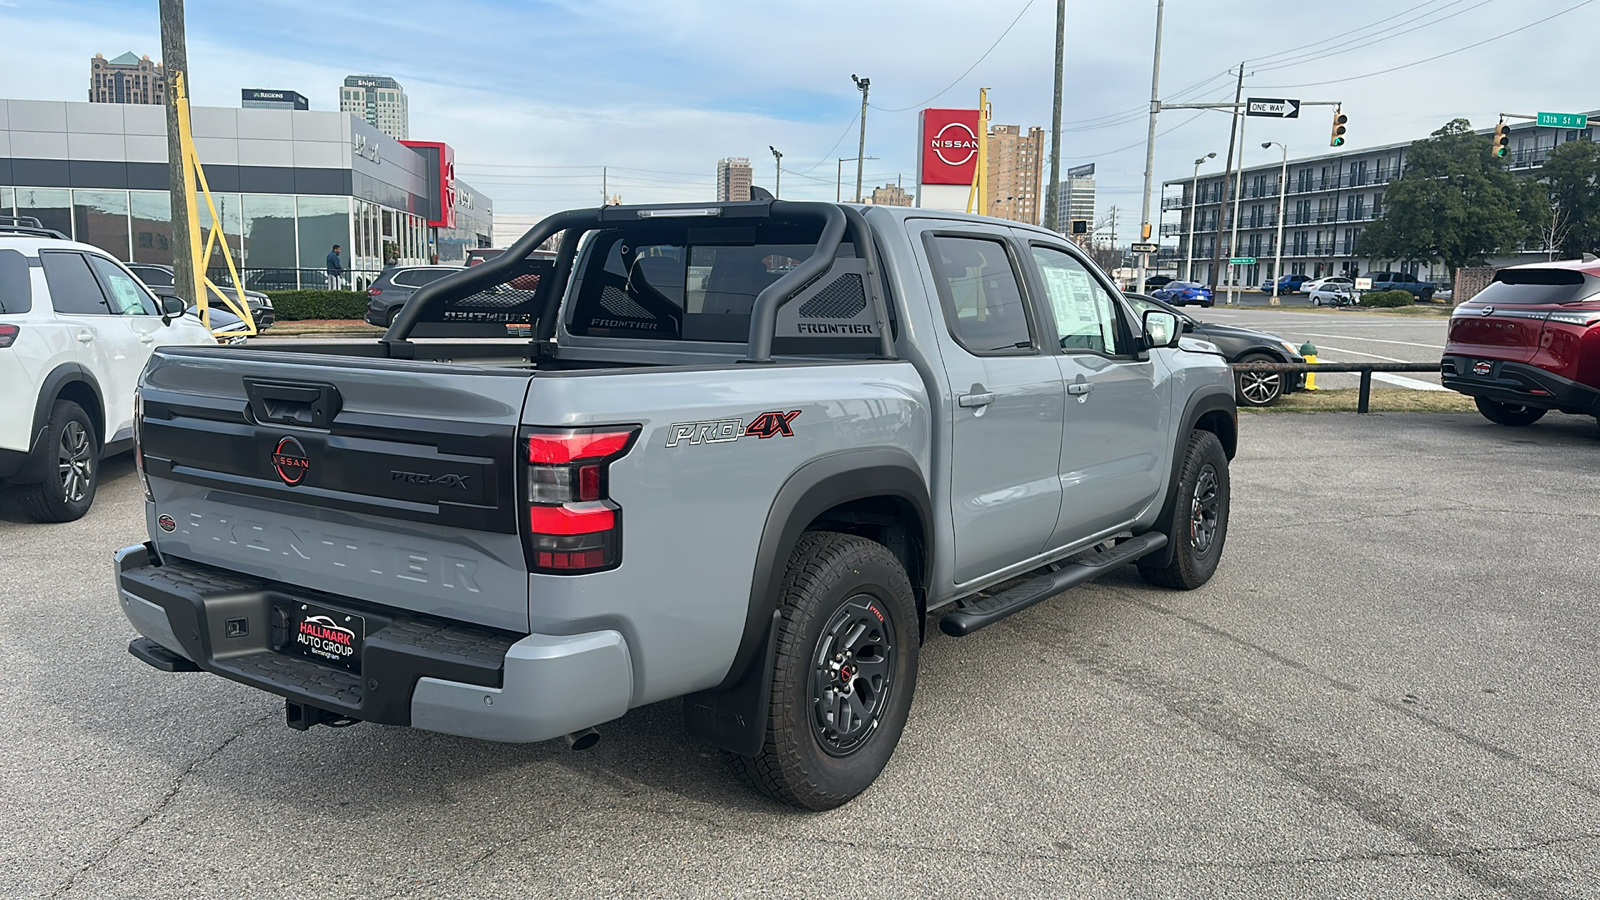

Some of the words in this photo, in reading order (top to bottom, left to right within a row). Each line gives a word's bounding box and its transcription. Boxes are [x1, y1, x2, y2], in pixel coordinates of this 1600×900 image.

[357, 80, 376, 88] Shipt
[1251, 103, 1267, 111] ONE
[1269, 104, 1285, 112] WAY
[1542, 115, 1558, 123] 13th
[1562, 116, 1571, 125] St
[1576, 117, 1582, 125] N
[931, 139, 979, 148] NISSAN
[590, 317, 658, 330] FRONTIER
[797, 323, 873, 334] FRONTIER
[665, 410, 802, 448] PRO-4X
[271, 454, 310, 468] NISSAN
[390, 469, 470, 490] PRO-4X
[300, 621, 351, 646] HALLMARK
[297, 633, 321, 648] AUTO
[322, 640, 354, 657] GROUP
[311, 647, 340, 661] Birmingham
